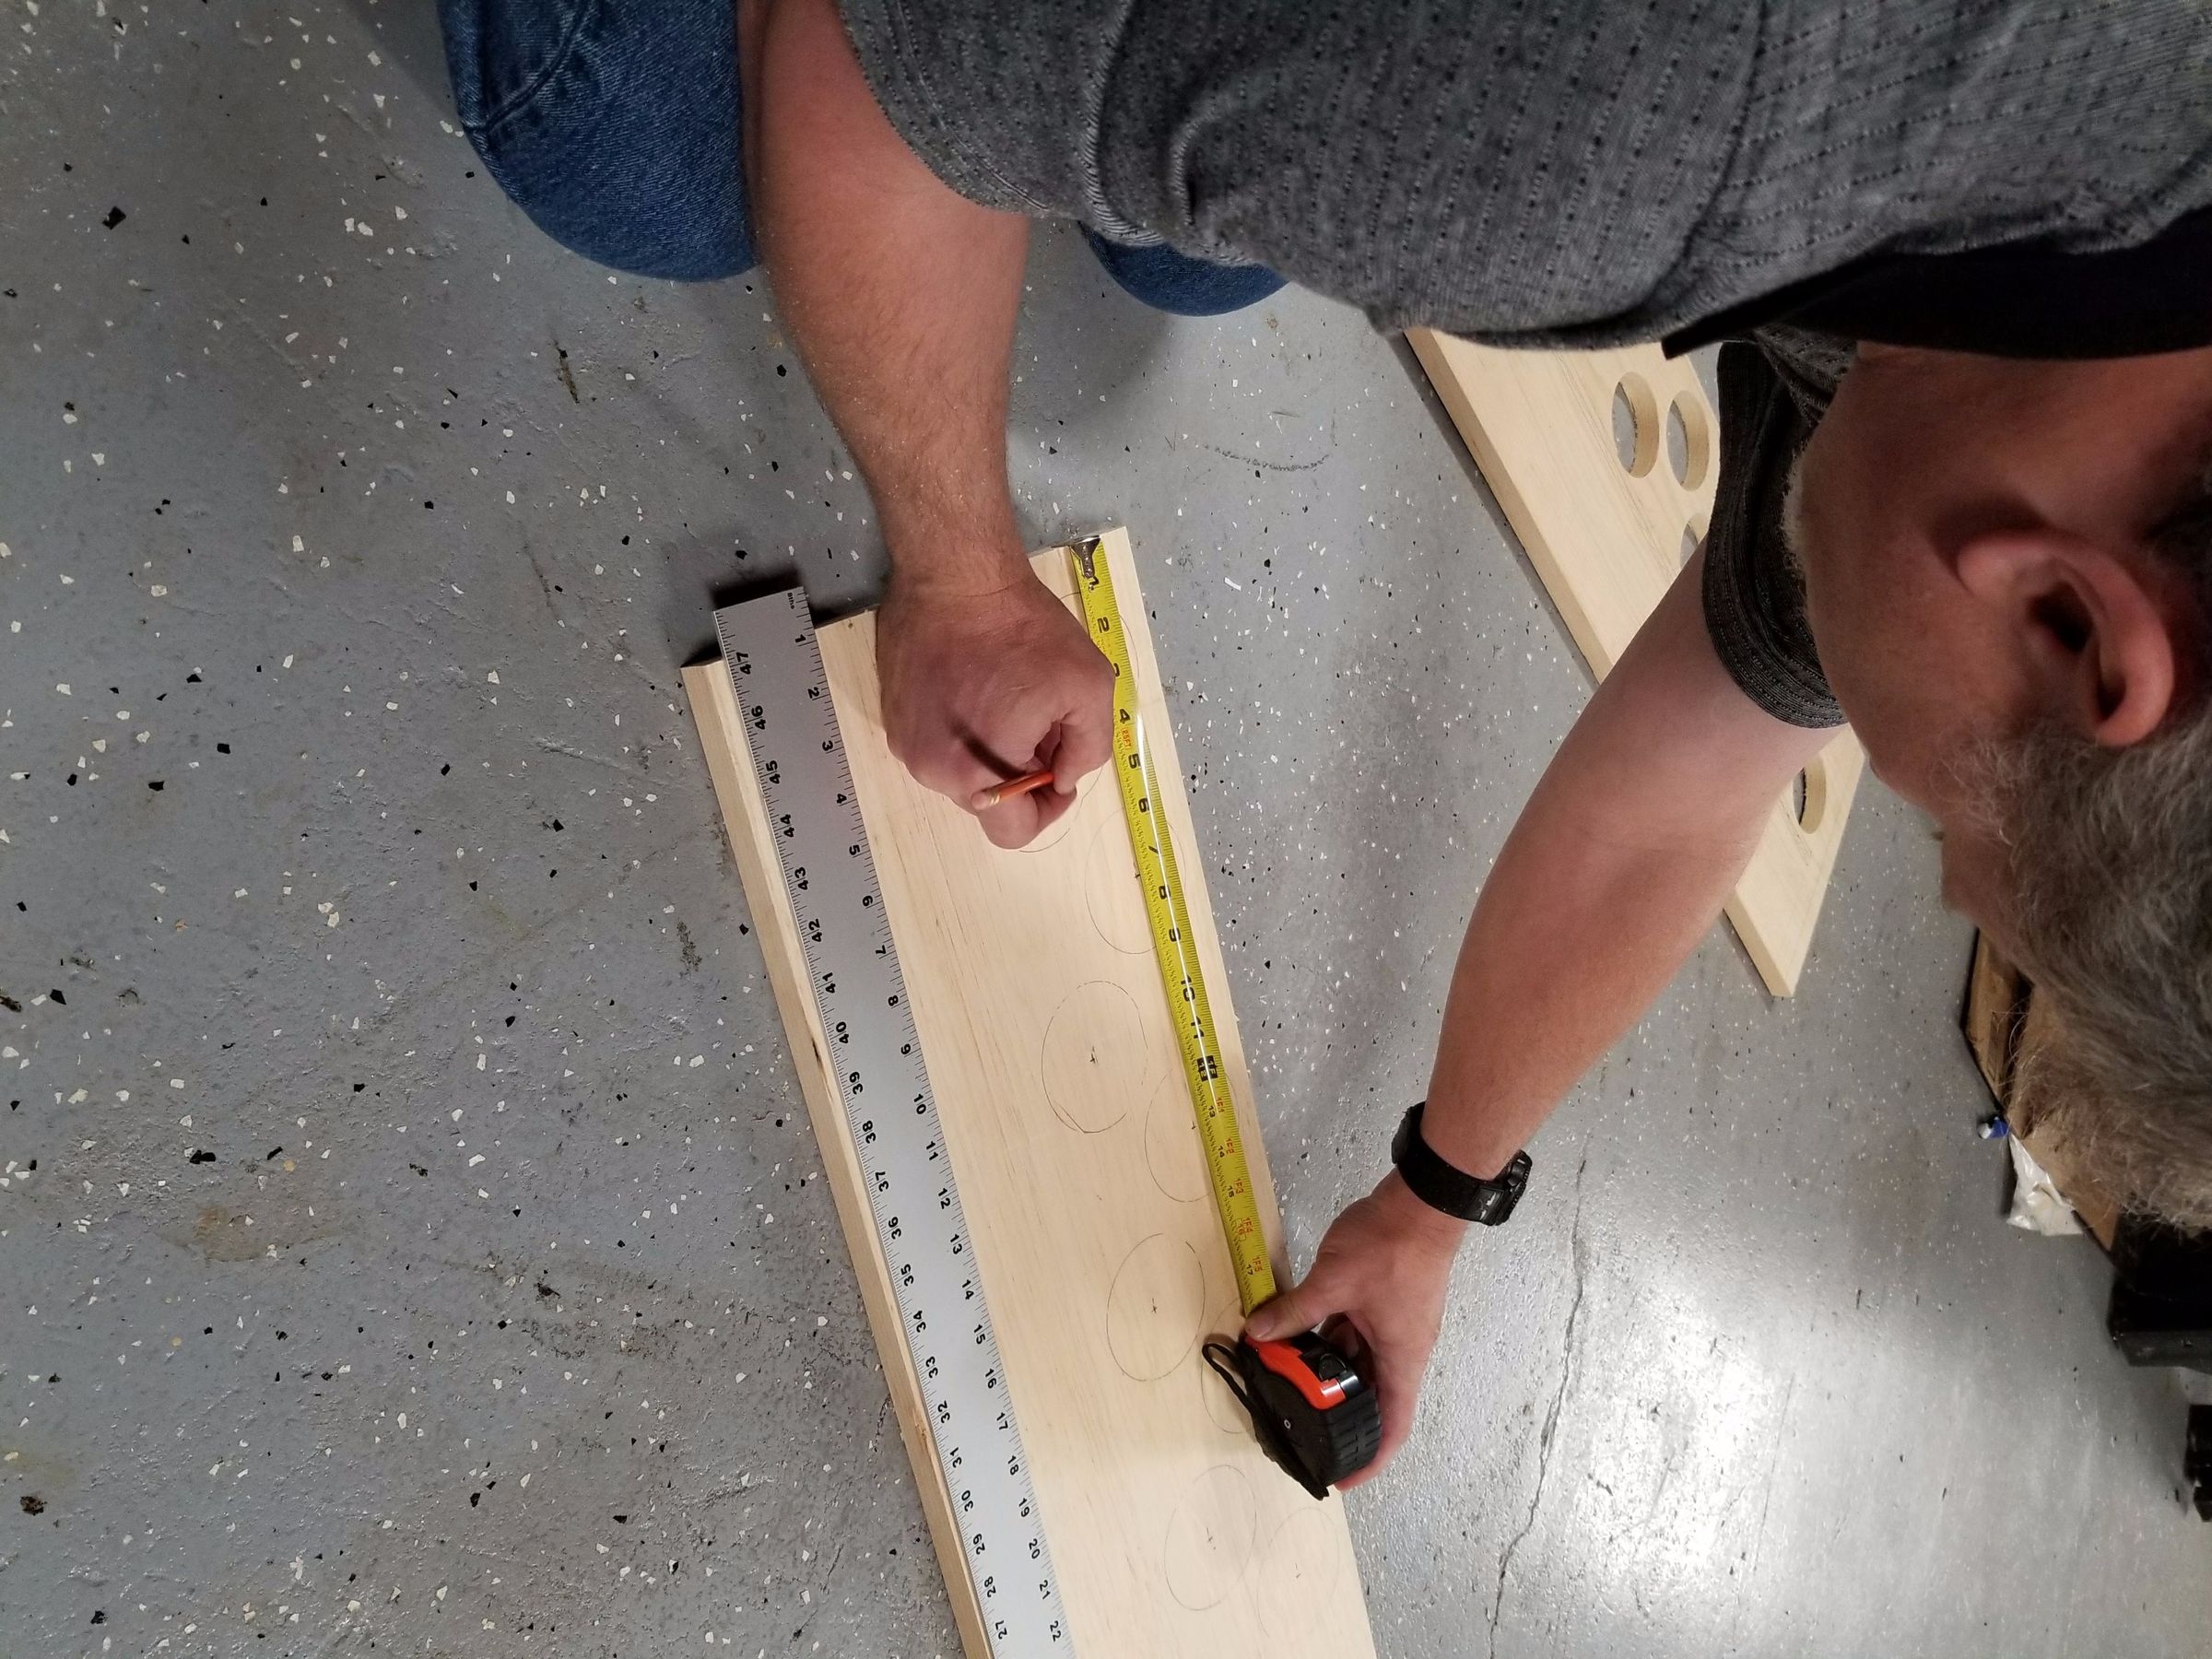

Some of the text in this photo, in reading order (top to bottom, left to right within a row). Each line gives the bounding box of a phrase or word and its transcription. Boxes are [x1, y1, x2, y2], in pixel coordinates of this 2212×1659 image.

[1098, 617, 1110, 633] 2
[1119, 708, 1130, 724] 4
[1128, 753, 1141, 769] 5
[1138, 797, 1150, 813] 6
[1159, 885, 1171, 900] 8
[1169, 927, 1181, 942] 9
[1181, 974, 1195, 1002] 10
[1191, 1016, 1205, 1039] 11
[735, 652, 1008, 1640] 27 28 29 30 31 32 33 34 35 36 37 38 39 40 41 42 43 44 45 46 47
[794, 633, 1062, 1642] 1 2 3 4 5 6 7 8 9 10 11 12 13 14 15 16 17 18 19 20 21 22
[1208, 1105, 1216, 1118] 13
[1218, 1145, 1225, 1158] 14
[1227, 1184, 1235, 1198] 15
[1246, 1264, 1253, 1275] 17
